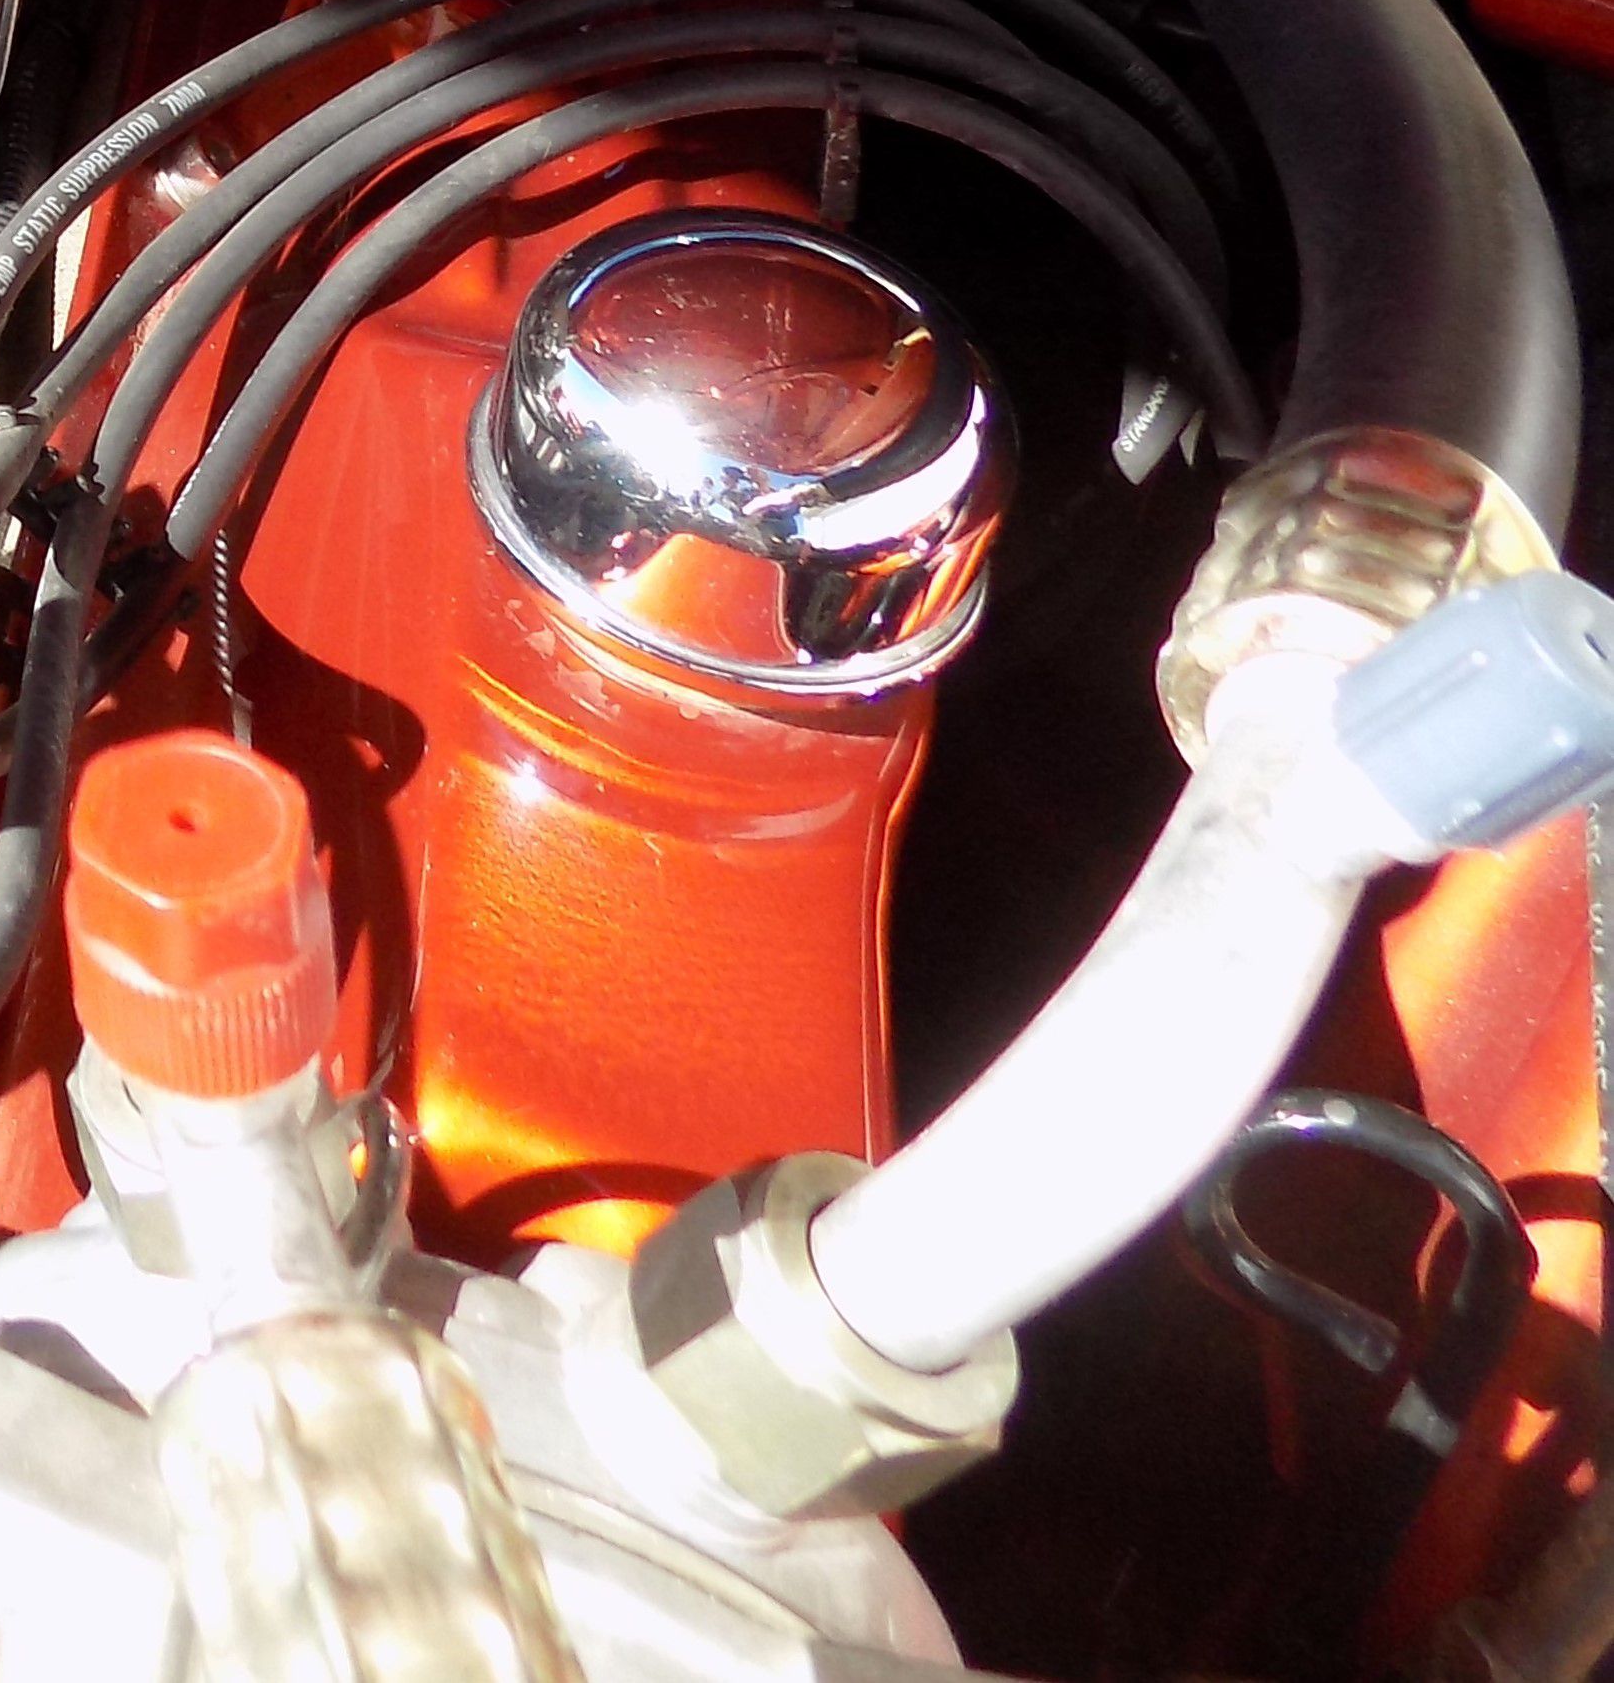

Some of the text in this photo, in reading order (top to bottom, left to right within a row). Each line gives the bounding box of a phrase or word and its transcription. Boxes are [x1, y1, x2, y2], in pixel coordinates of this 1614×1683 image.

[11, 195, 68, 256] STATIC
[57, 111, 161, 202] SUPPRESSION
[159, 79, 208, 118] 7MM
